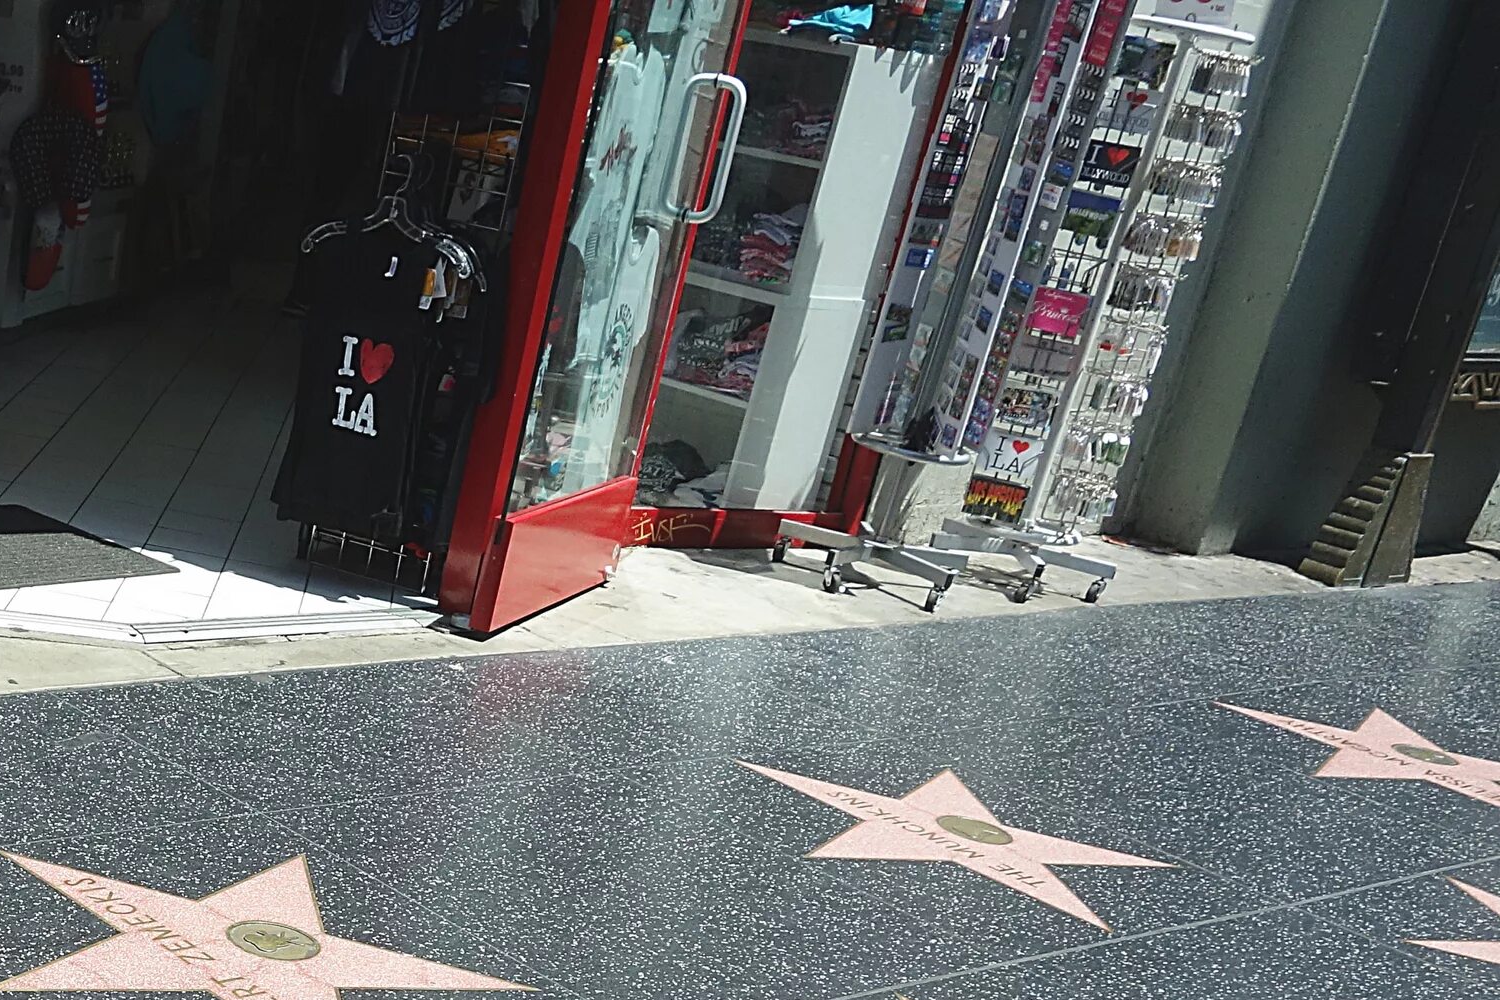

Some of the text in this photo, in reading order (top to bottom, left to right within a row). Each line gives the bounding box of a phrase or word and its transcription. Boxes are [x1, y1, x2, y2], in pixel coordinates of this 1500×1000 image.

[1086, 144, 1104, 165] I
[338, 335, 358, 376] I
[331, 386, 377, 437] LA
[990, 452, 1021, 474] LA
[995, 436, 1008, 452] I
[826, 790, 1048, 889] THE MUNCHKINS
[61, 876, 217, 965] ZEMECKIS
